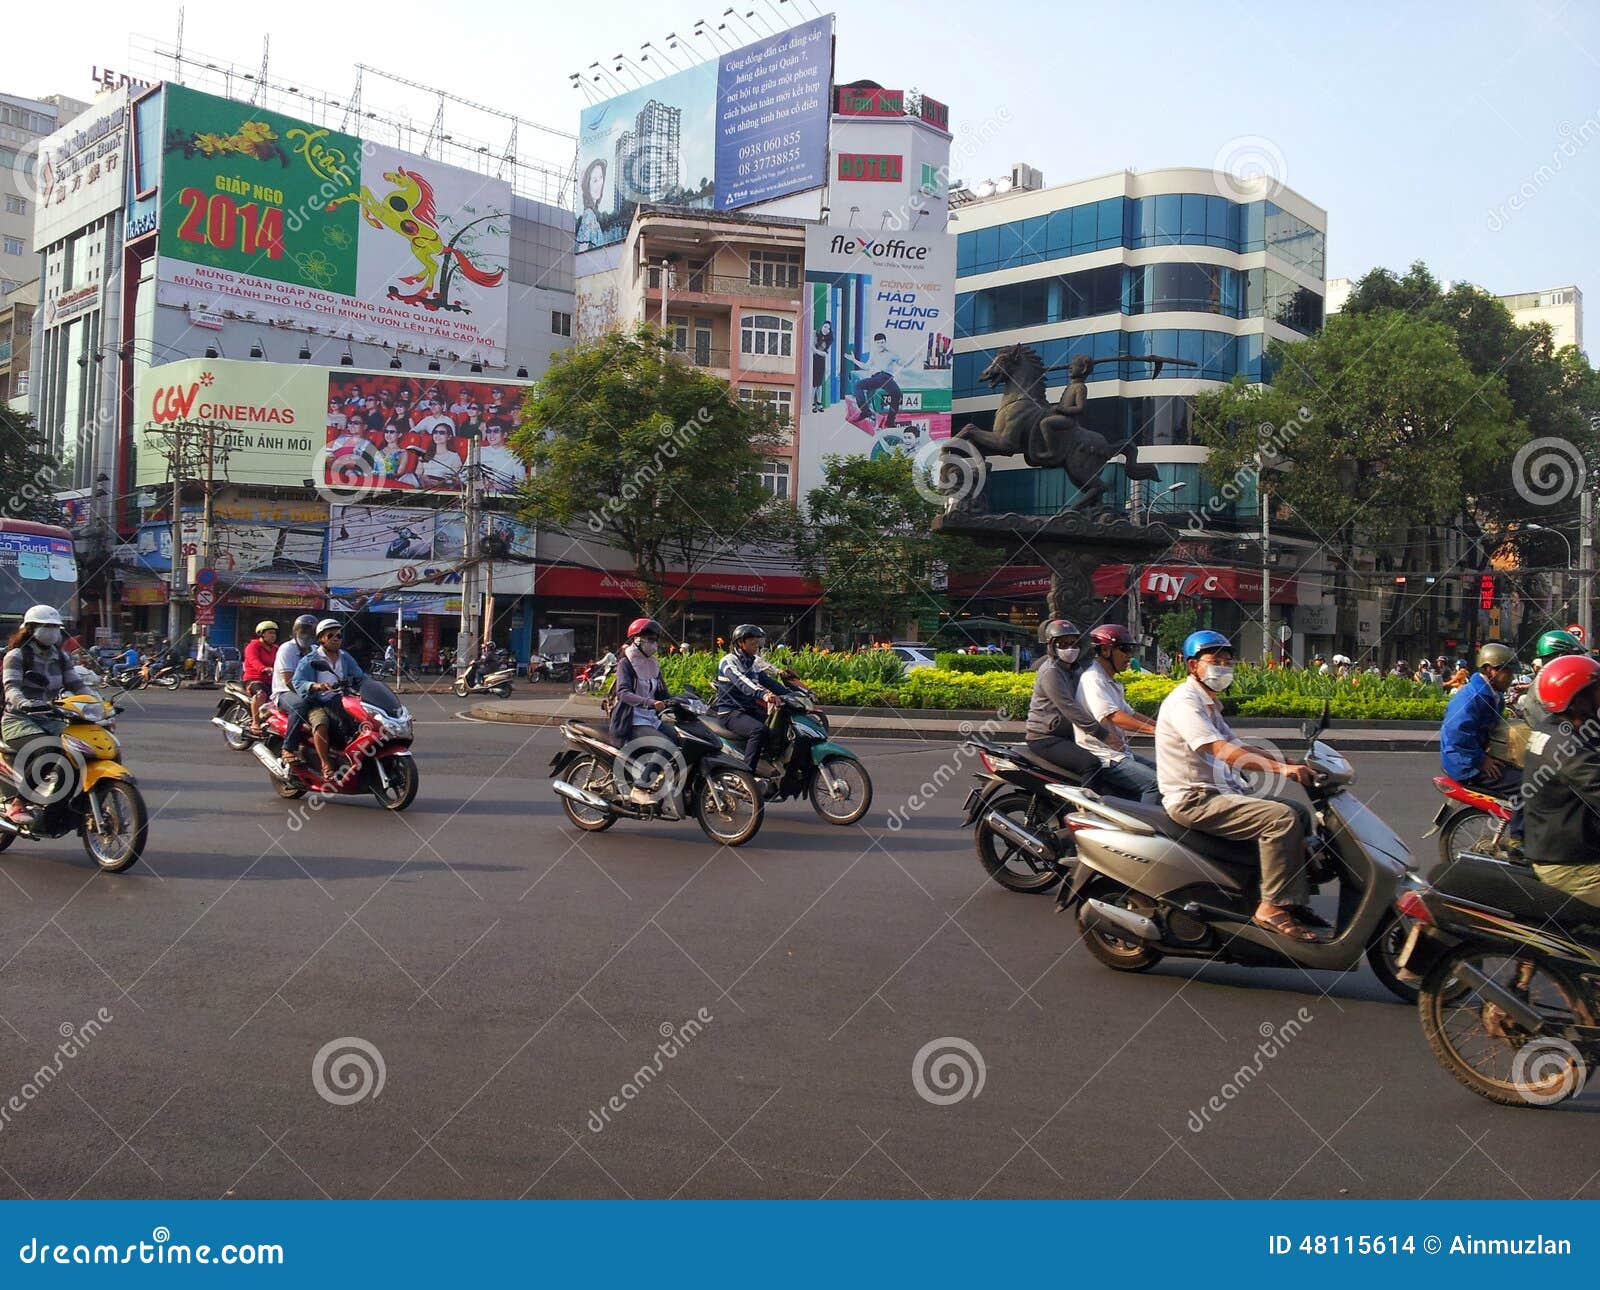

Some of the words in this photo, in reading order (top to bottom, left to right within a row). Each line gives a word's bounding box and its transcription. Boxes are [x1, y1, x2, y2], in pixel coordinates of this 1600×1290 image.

[92, 65, 114, 86] LE
[97, 132, 121, 160] Bank
[739, 143, 761, 160] 0938
[763, 137, 781, 153] 060
[783, 130, 801, 144] 855
[739, 162, 750, 176] 08
[752, 147, 800, 172] 37738855
[841, 157, 899, 178] HOTEL
[216, 175, 250, 195] GIÁP
[177, 187, 286, 260] 2014
[339, 308, 366, 320] MINH
[453, 332, 474, 342] CAO
[413, 313, 450, 327] QUANG
[453, 321, 480, 334] VINH,
[152, 382, 199, 424] CGV
[906, 397, 919, 407] A4
[199, 403, 295, 424] CINEMAS
[738, 583, 764, 593] cardin
